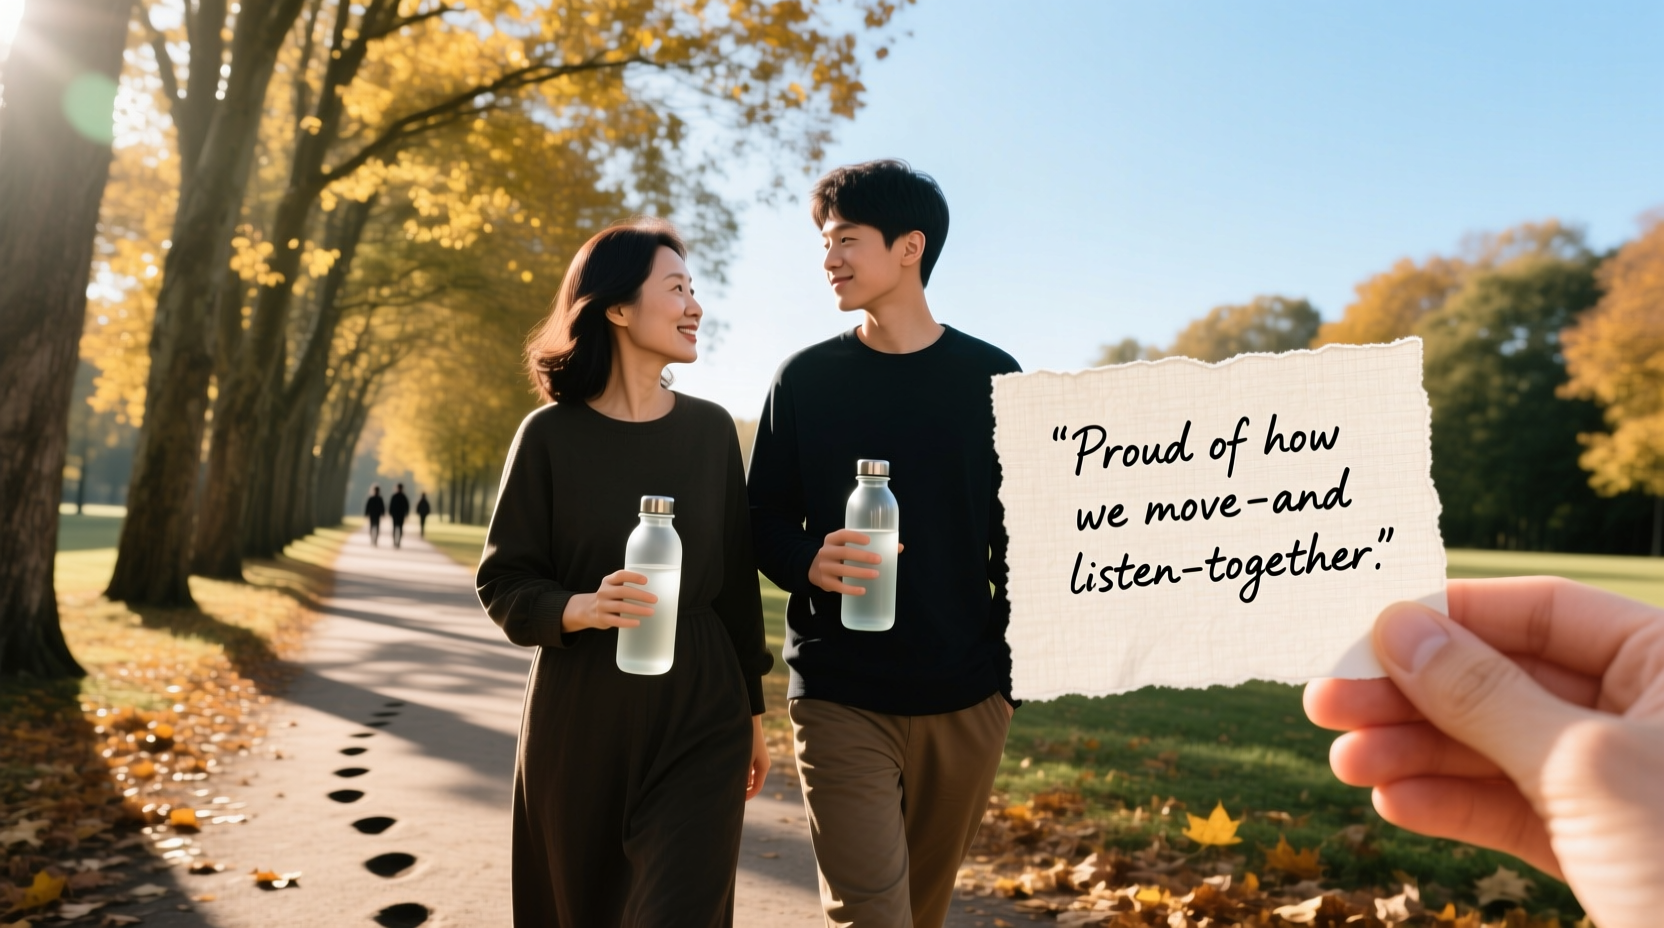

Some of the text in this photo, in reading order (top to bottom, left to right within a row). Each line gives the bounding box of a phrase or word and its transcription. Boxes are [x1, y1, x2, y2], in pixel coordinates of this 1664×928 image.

[1209, 416, 1250, 479] of
[1263, 413, 1340, 456] how
[1076, 503, 1129, 532] we
